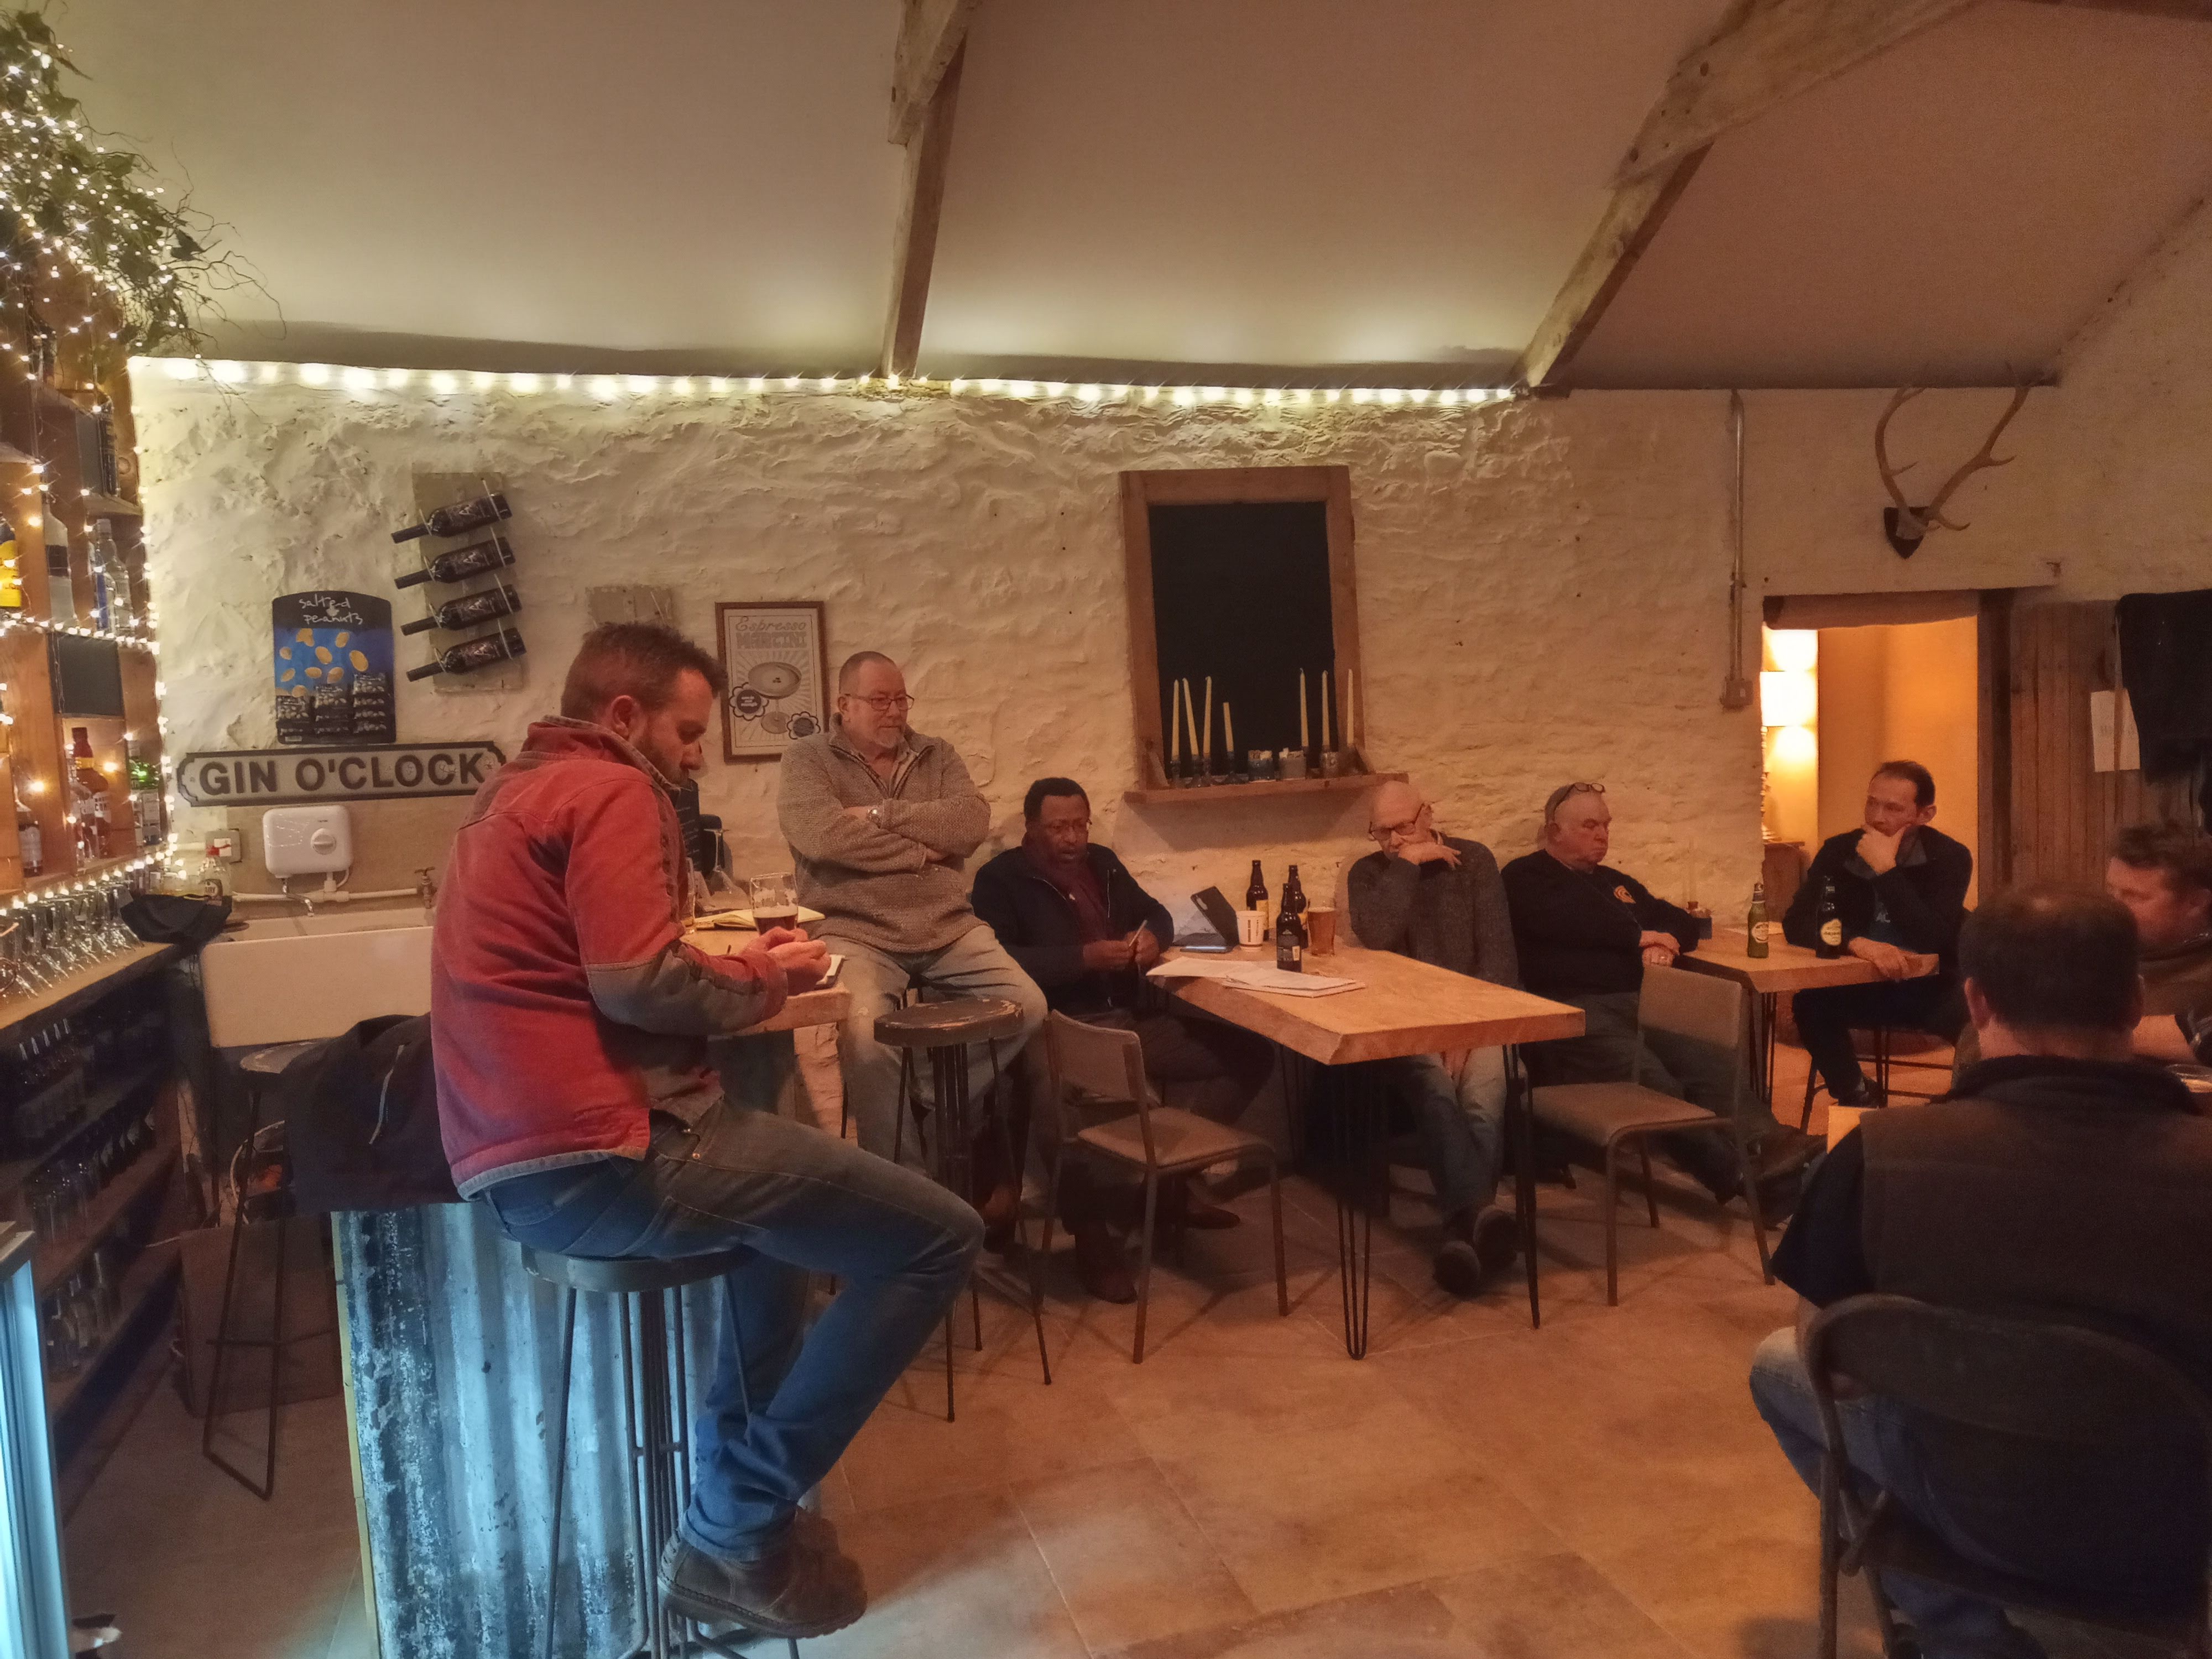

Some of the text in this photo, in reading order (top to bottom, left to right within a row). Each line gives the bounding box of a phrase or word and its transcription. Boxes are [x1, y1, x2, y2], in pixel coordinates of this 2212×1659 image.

[735, 615, 806, 631] Espresso
[736, 631, 807, 649] MARTINI
[200, 752, 484, 795] GIN O'CLOCK
